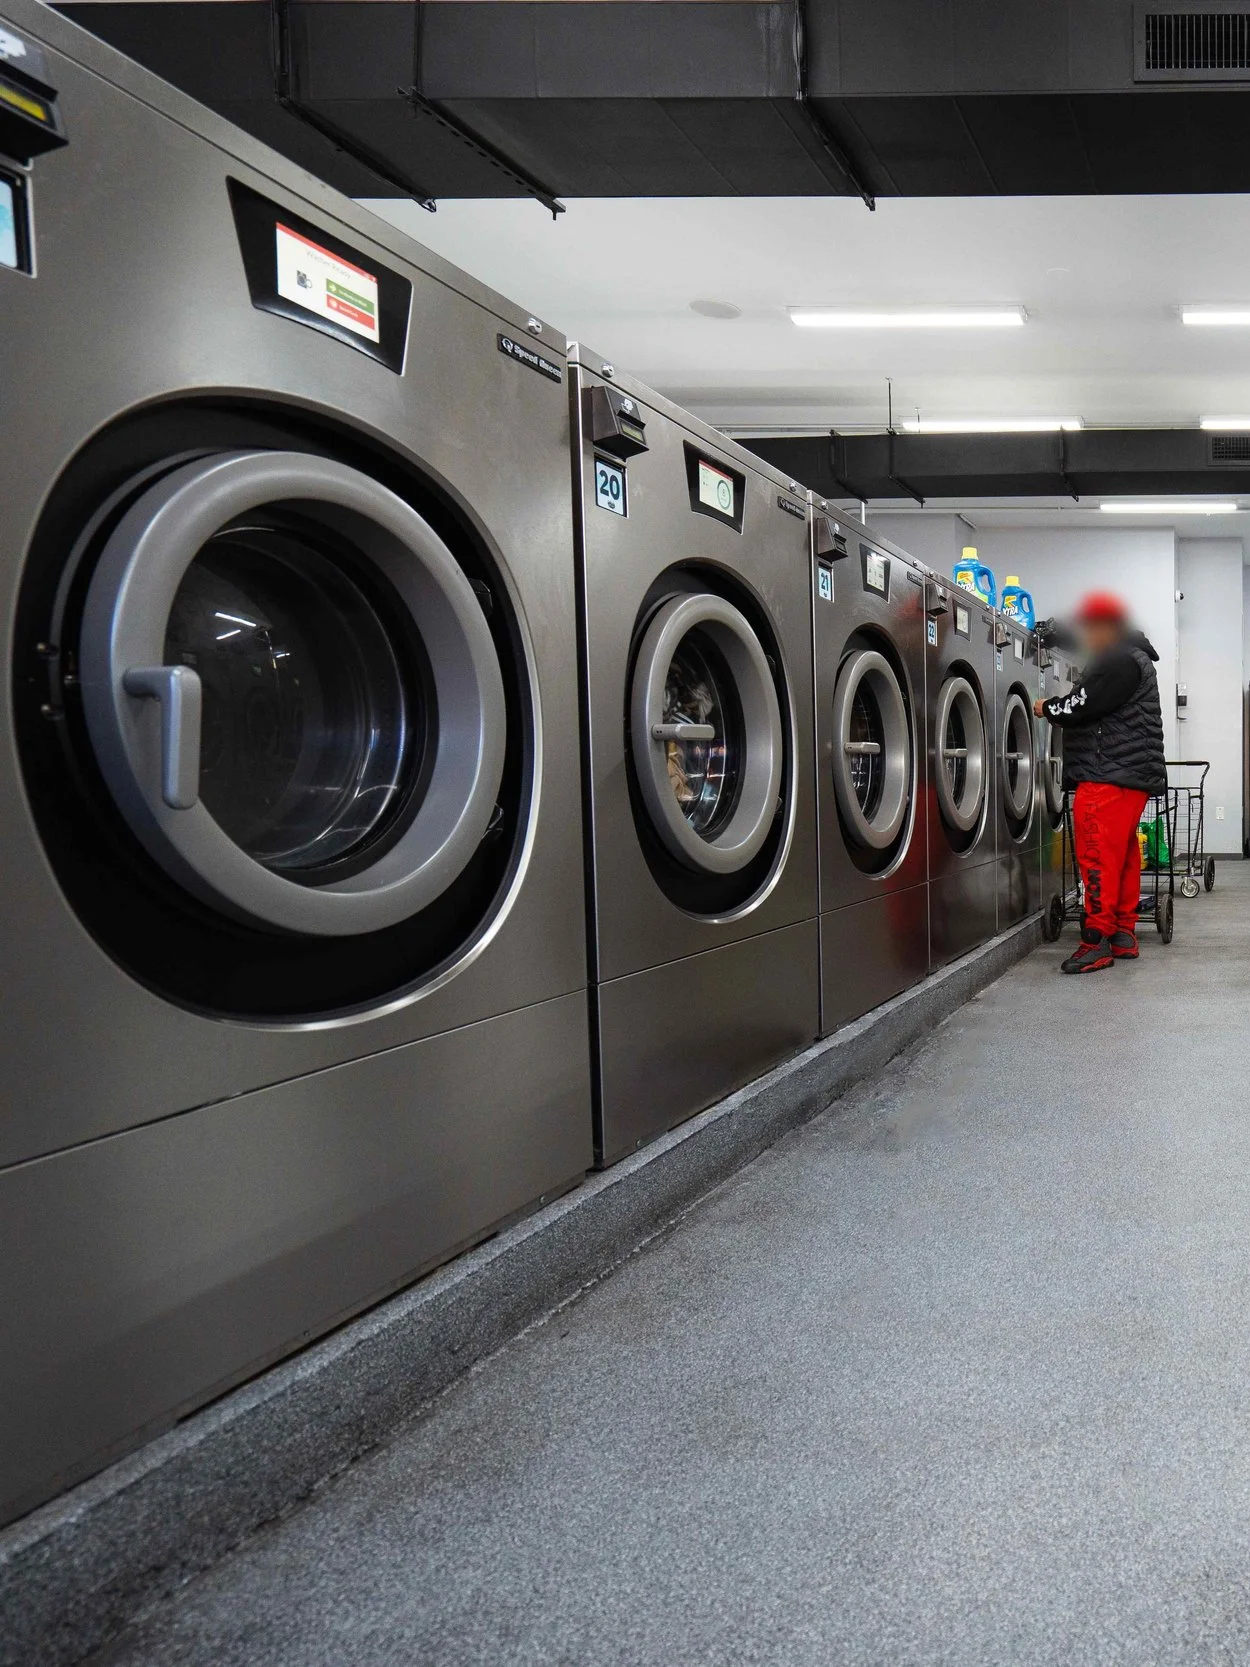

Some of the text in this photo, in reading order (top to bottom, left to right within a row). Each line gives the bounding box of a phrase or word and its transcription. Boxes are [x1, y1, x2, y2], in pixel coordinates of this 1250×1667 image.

[599, 469, 621, 501] 20
[821, 572, 829, 591] 21
[928, 622, 935, 638] 22
[1083, 803, 1102, 915] FASHIO NOVA
